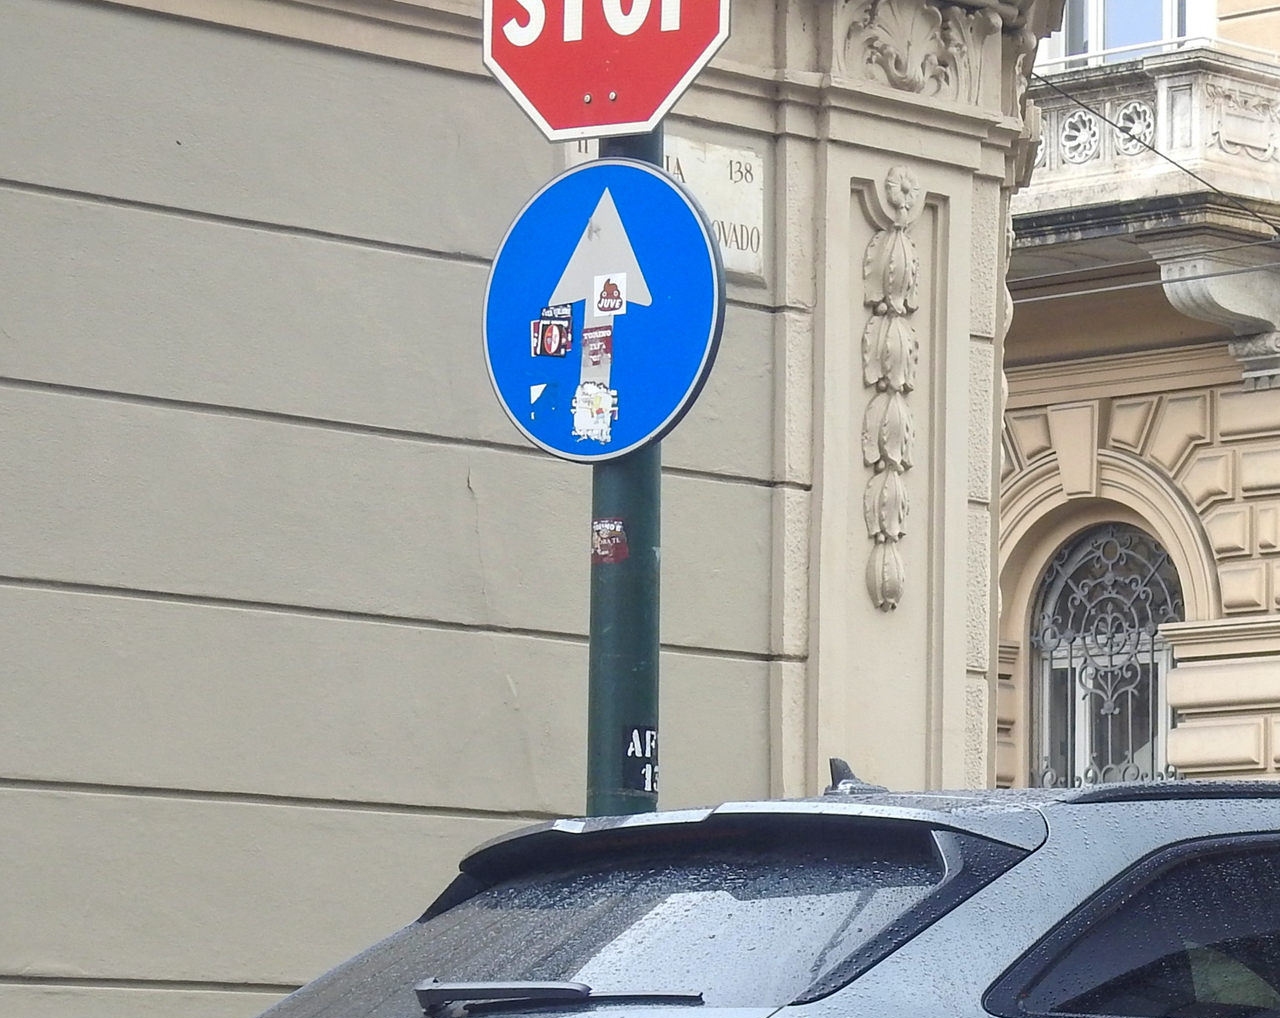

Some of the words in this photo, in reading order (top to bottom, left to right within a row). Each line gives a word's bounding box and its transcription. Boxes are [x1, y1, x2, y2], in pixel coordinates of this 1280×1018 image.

[664, 155, 686, 184] IA
[728, 160, 754, 184] 138
[712, 219, 760, 253] OVADO
[598, 297, 622, 309] JUVE
